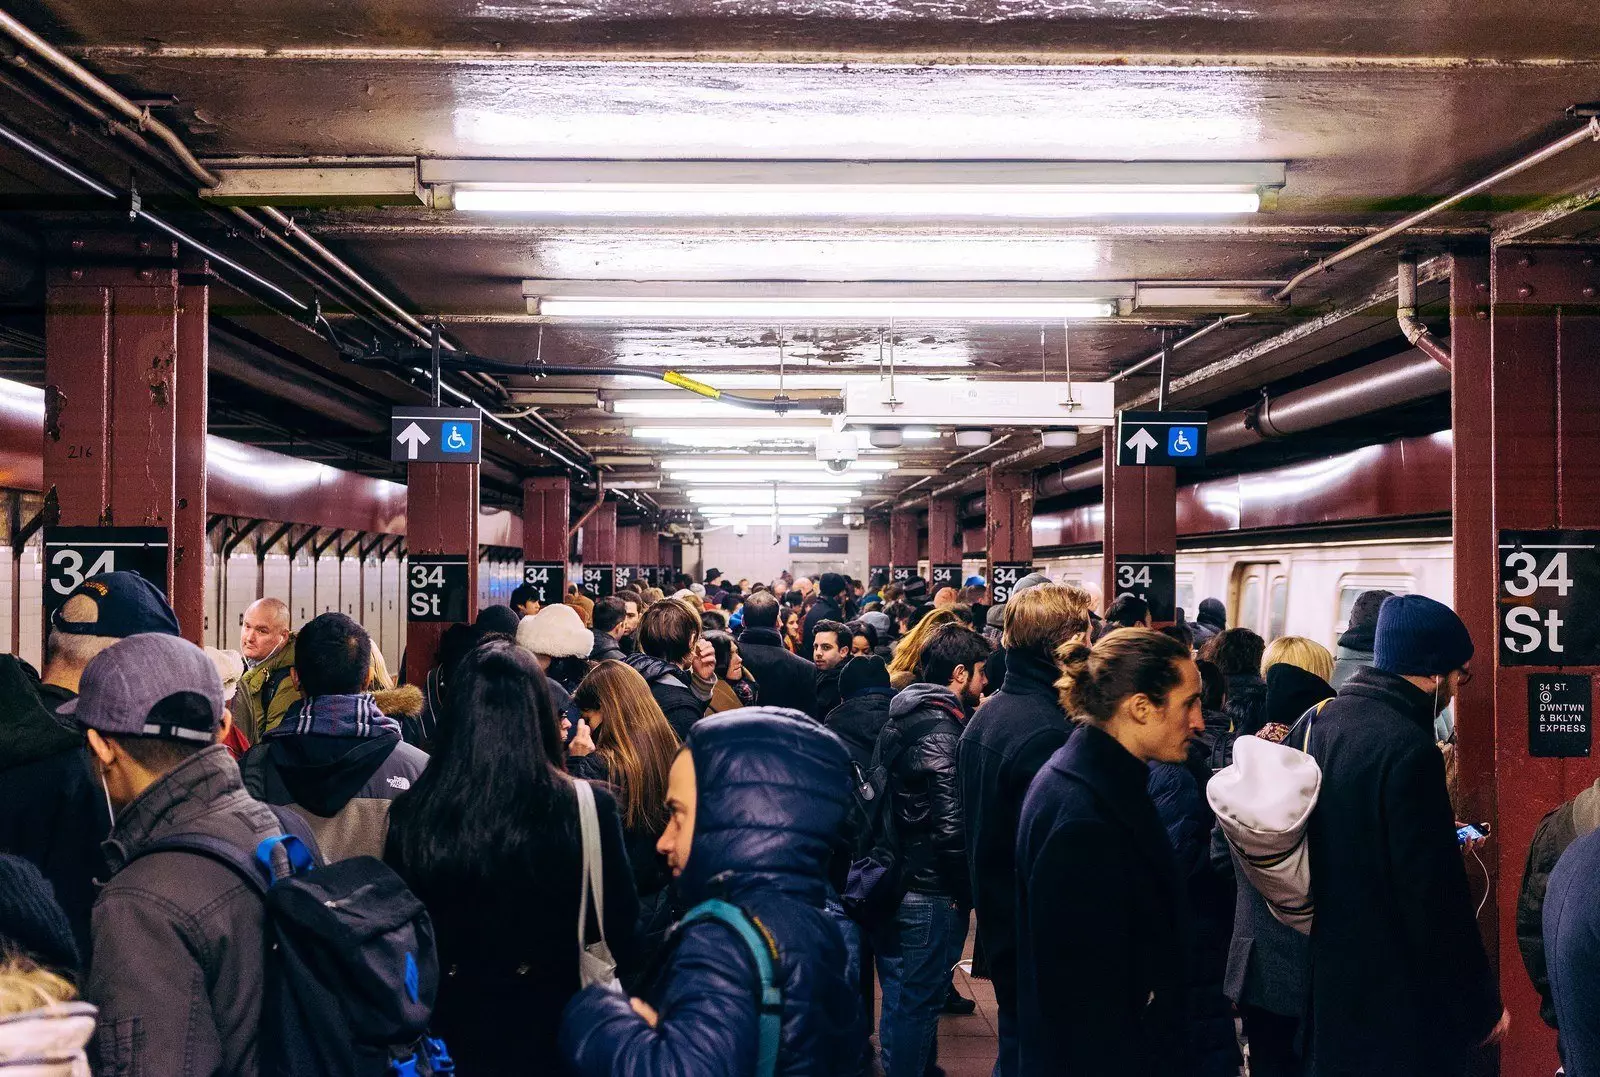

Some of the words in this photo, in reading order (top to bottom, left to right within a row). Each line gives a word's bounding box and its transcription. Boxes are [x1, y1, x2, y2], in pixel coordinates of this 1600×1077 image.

[411, 565, 446, 589] 34
[525, 568, 549, 584] 34
[584, 569, 602, 582] 34
[615, 567, 631, 578] 34
[894, 569, 910, 580] 34
[933, 568, 952, 582] 34
[993, 568, 1018, 584] 34
[1118, 565, 1152, 588] 34
[1504, 552, 1574, 597] 34
[410, 592, 441, 616] St
[1504, 606, 1564, 653] St
[1539, 683, 1551, 691] 34
[1554, 683, 1569, 691] ST.
[1539, 704, 1585, 712] DWNTWN
[1539, 714, 1546, 722] &
[1549, 714, 1582, 722] BKLYN
[1539, 724, 1586, 733] EXPRESS
